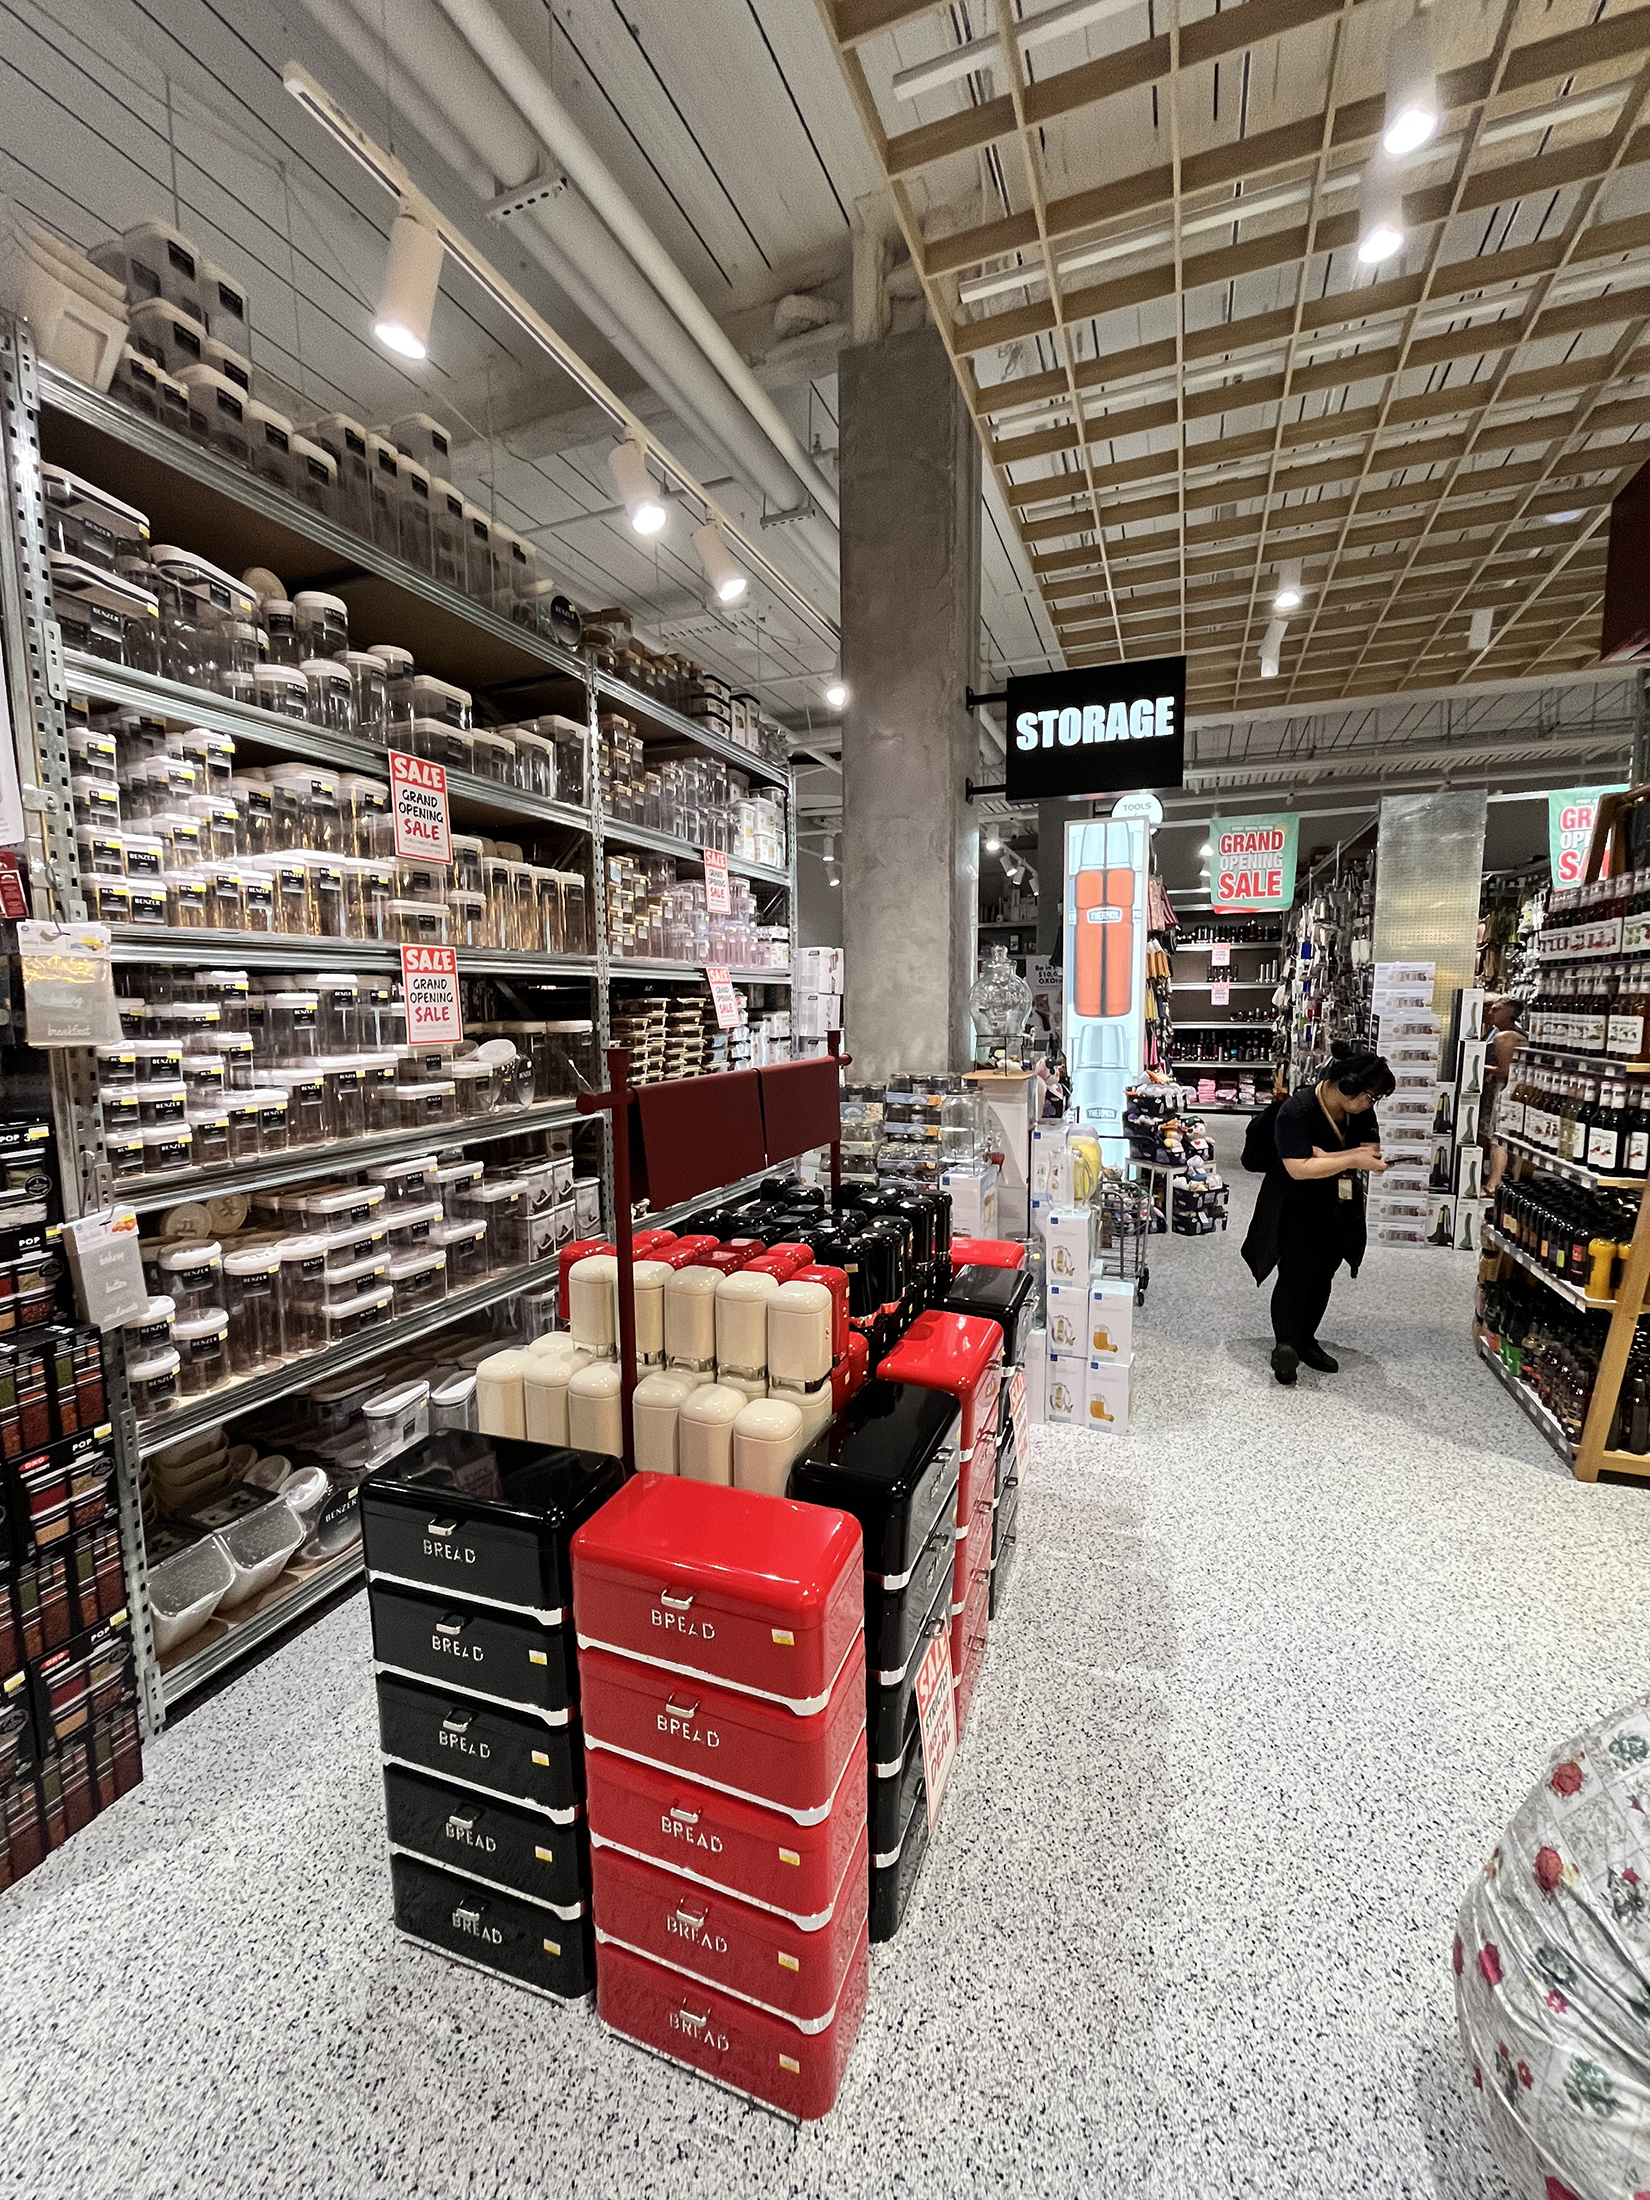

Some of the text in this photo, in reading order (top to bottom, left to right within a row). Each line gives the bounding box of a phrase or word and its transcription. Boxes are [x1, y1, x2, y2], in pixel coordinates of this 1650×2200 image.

[1016, 696, 1175, 751] STORAGE
[394, 757, 443, 788] SALE
[402, 789, 438, 808] GRAND
[398, 802, 444, 824] OPENING
[1122, 802, 1152, 812] TOOLS
[404, 818, 440, 840] SALE
[1220, 831, 1284, 854] GRAND
[129, 853, 156, 861] BENZER
[706, 850, 726, 867] SALE
[1220, 852, 1283, 872] OPENING
[708, 869, 723, 878] GRAND
[1219, 870, 1281, 899] SALE
[710, 887, 724, 899] SALE
[134, 898, 161, 906] BENZER
[1090, 911, 1119, 920] THERMOS
[406, 949, 453, 971] SALE
[709, 968, 730, 983] SALE
[413, 978, 447, 990] GRAND
[410, 992, 454, 1004] OPENING
[415, 1006, 450, 1023] SALE
[719, 1002, 733, 1014] SALE
[48, 1023, 91, 1036] breakfast
[156, 1101, 181, 1109] BENZER
[1088, 1109, 1115, 1118] THERMOS
[161, 1143, 186, 1151] BENZER
[19, 1236, 40, 1247] POP
[183, 1267, 209, 1278] BENZER
[243, 1274, 267, 1283] BENZER
[141, 1322, 168, 1334] BENZER
[192, 1336, 218, 1347] BENZER
[148, 1374, 174, 1387] BENZER
[72, 1438, 92, 1452] POP
[25, 1456, 46, 1468] OXO
[325, 1497, 356, 1521] BENZER
[423, 1538, 476, 1564] BREAD
[651, 1608, 716, 1640] BREAD
[91, 1626, 110, 1642] POP
[432, 1634, 484, 1662] BREAD
[45, 1652, 64, 1665] OXO
[657, 1714, 720, 1748] BREAD
[438, 1730, 490, 1758] BREAD
[930, 1721, 951, 1787] DEAL
[446, 1822, 496, 1852] BREAD
[661, 1815, 723, 1853] BREAD
[452, 1912, 502, 1944] BREAD
[667, 1915, 728, 1954] BREAD
[669, 2012, 729, 2052] BREAD
